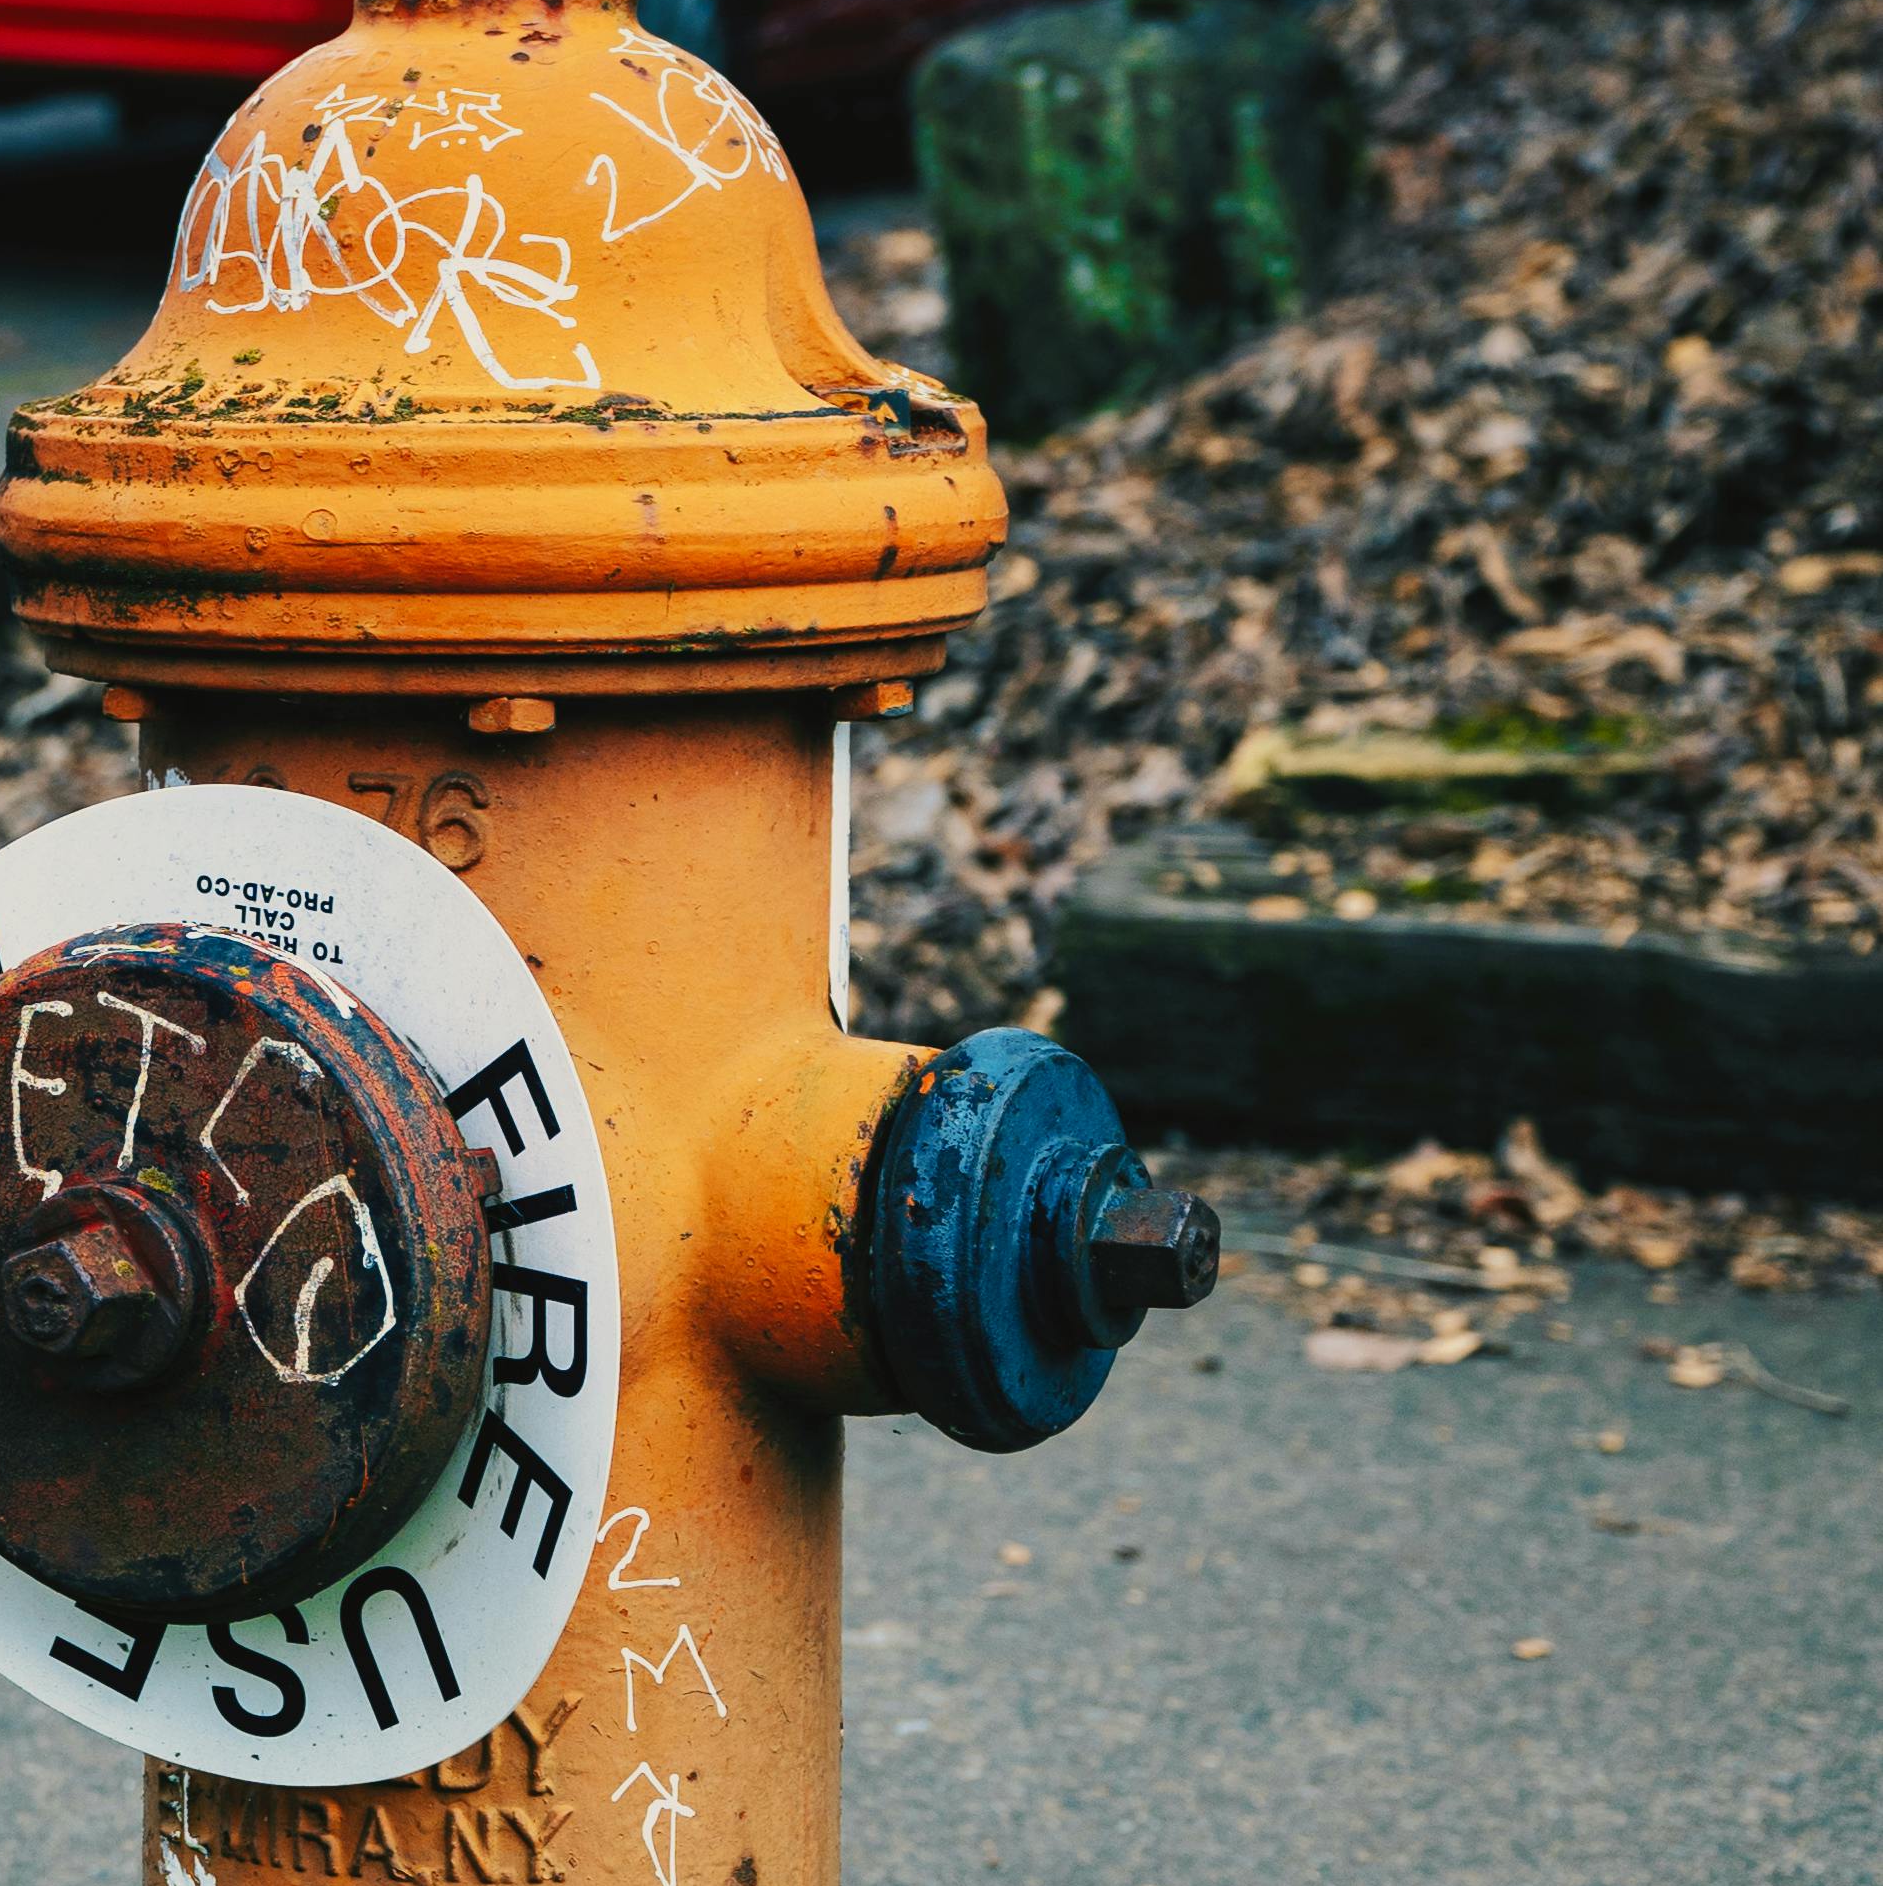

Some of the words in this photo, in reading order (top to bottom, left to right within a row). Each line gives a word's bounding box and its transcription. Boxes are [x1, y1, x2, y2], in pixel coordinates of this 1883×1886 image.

[197, 875, 334, 914] PRO-AD-CO
[235, 904, 295, 931] CALL
[313, 942, 343, 964] TO
[445, 1037, 590, 1580] FIRE
[49, 1565, 462, 1738] USE
